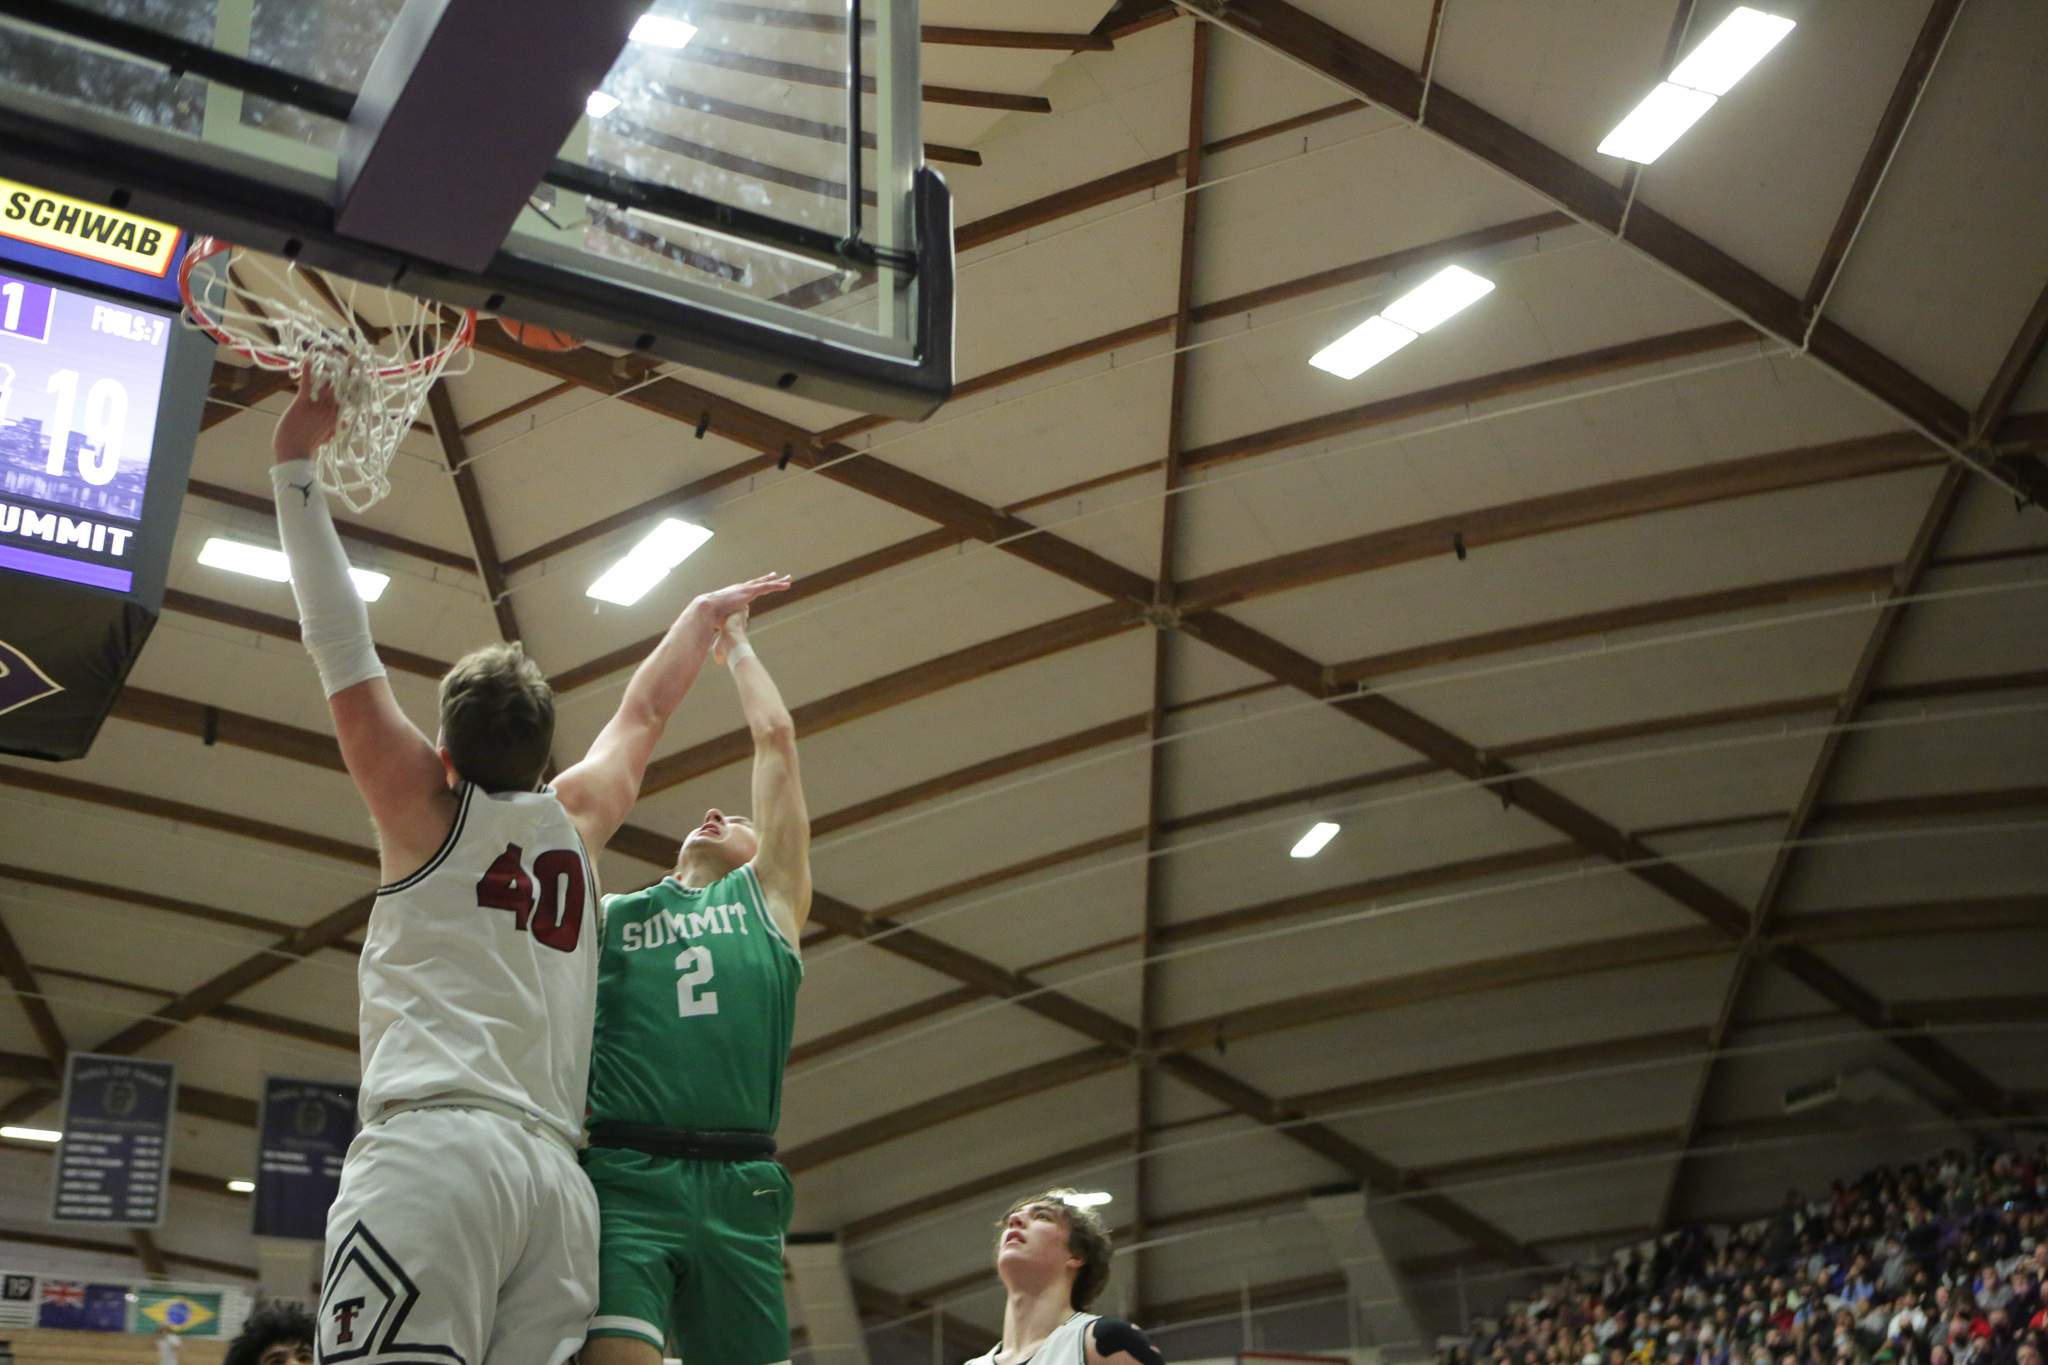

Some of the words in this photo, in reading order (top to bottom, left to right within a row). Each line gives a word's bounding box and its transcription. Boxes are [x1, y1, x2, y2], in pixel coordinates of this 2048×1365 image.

[5, 192, 161, 256] SCHWAB
[2, 282, 24, 331] 1
[46, 369, 129, 486] 19
[476, 842, 586, 953] 40
[622, 901, 748, 952] SUMMIT
[675, 945, 719, 1018] 2
[332, 1296, 366, 1346] T
